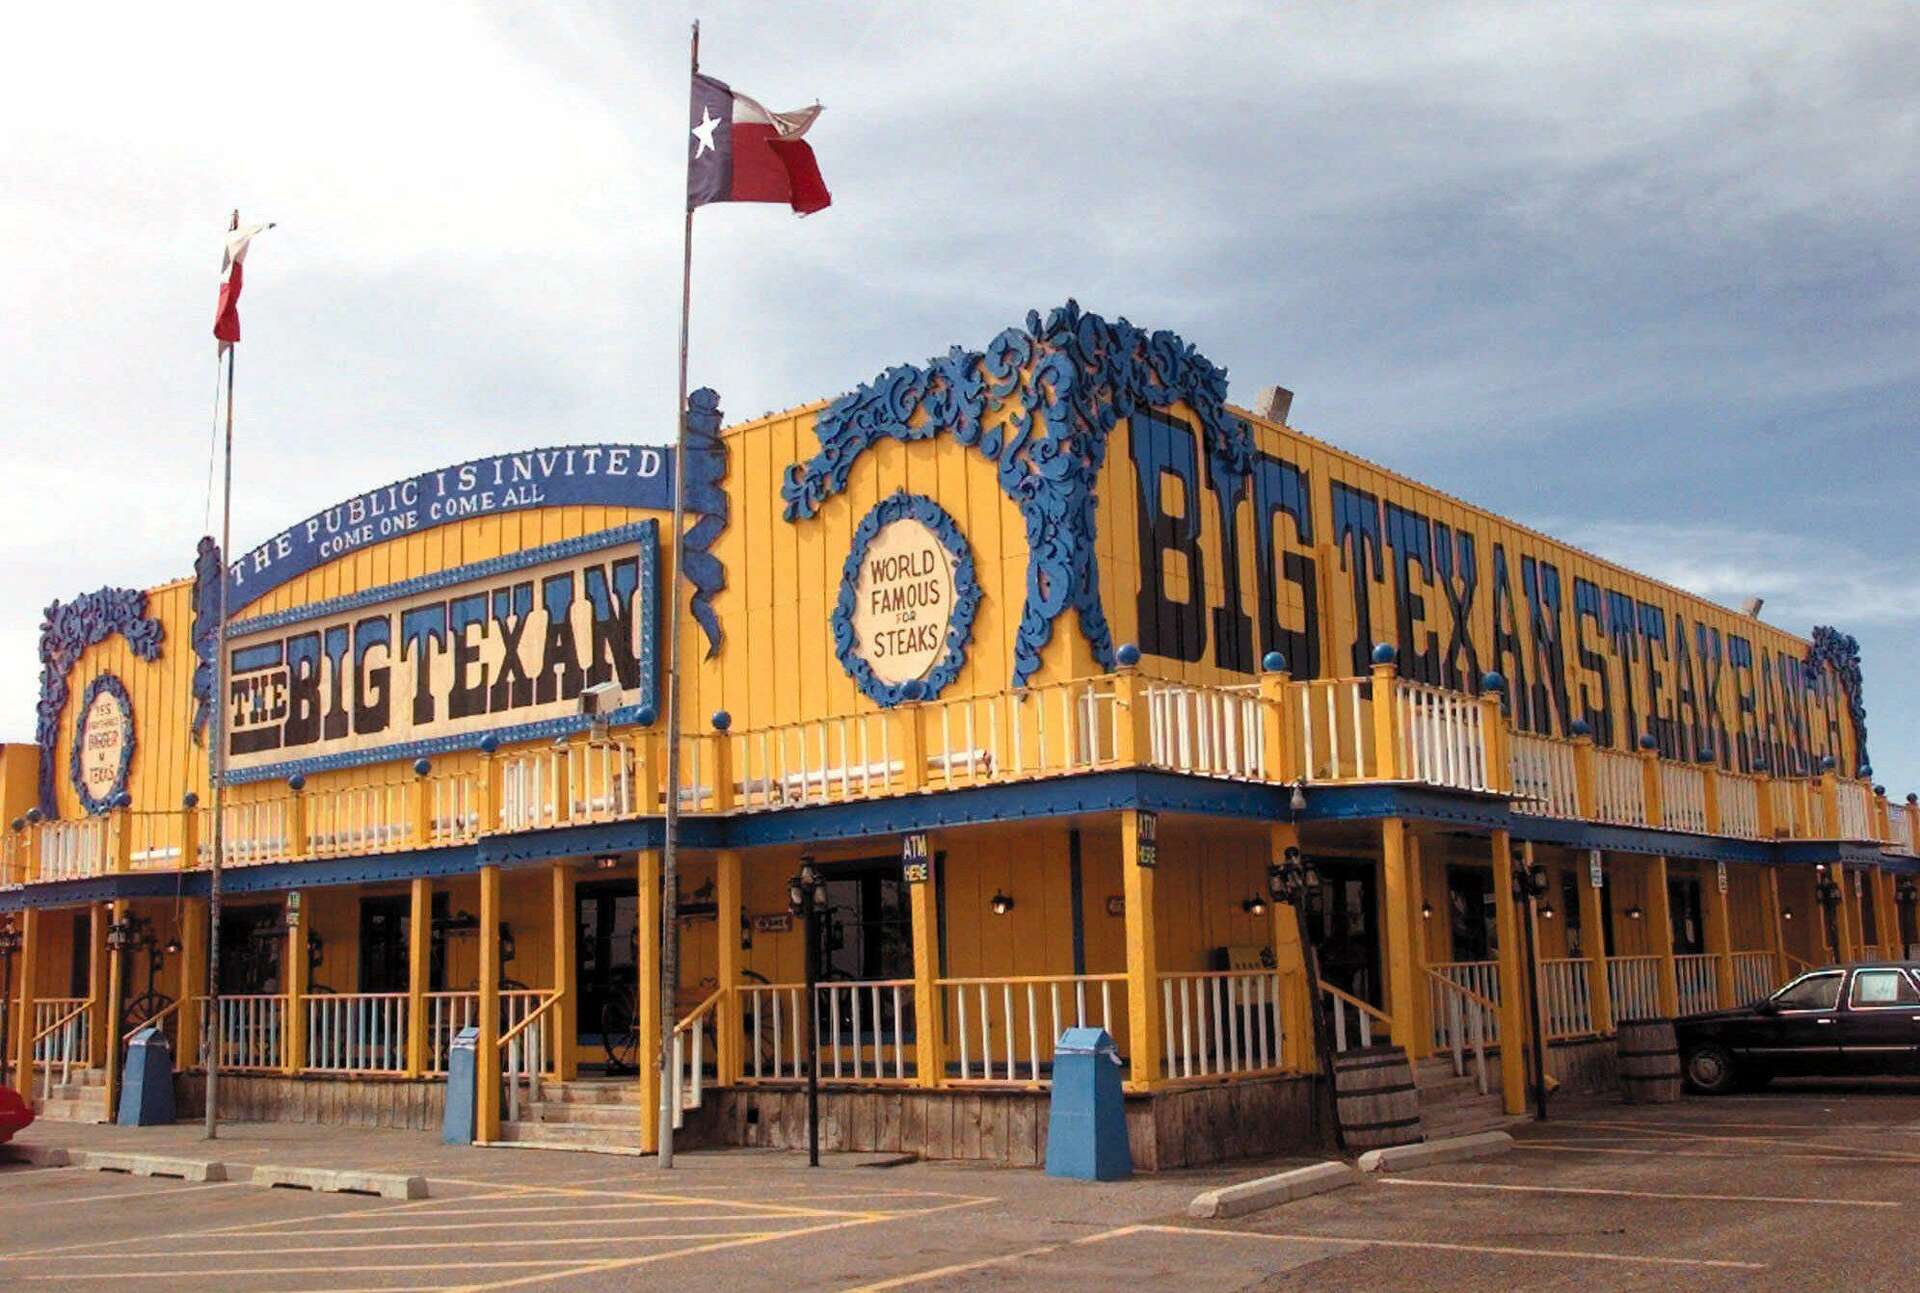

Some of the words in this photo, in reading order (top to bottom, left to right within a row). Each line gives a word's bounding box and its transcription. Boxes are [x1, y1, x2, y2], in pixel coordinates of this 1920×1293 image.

[229, 533, 292, 587] THE
[306, 481, 418, 543] PUBLIC
[436, 461, 478, 497] IS
[493, 449, 662, 486] INVITED
[319, 525, 373, 558] COME
[380, 511, 419, 541] ONE
[430, 492, 494, 520] COME
[502, 483, 545, 506] ALL
[870, 549, 935, 584] WORLD
[871, 579, 940, 615] FAMOUS
[1128, 404, 1321, 681] BIG
[1330, 478, 1571, 738] TEXAN
[1574, 575, 1732, 773] STEAK
[896, 611, 916, 625] FOR
[230, 670, 288, 728] THE
[284, 613, 392, 748] BIG
[400, 555, 641, 727] TEXAN
[873, 624, 938, 658] STEAKS
[903, 834, 928, 860] ATM
[903, 863, 928, 882] HERE
